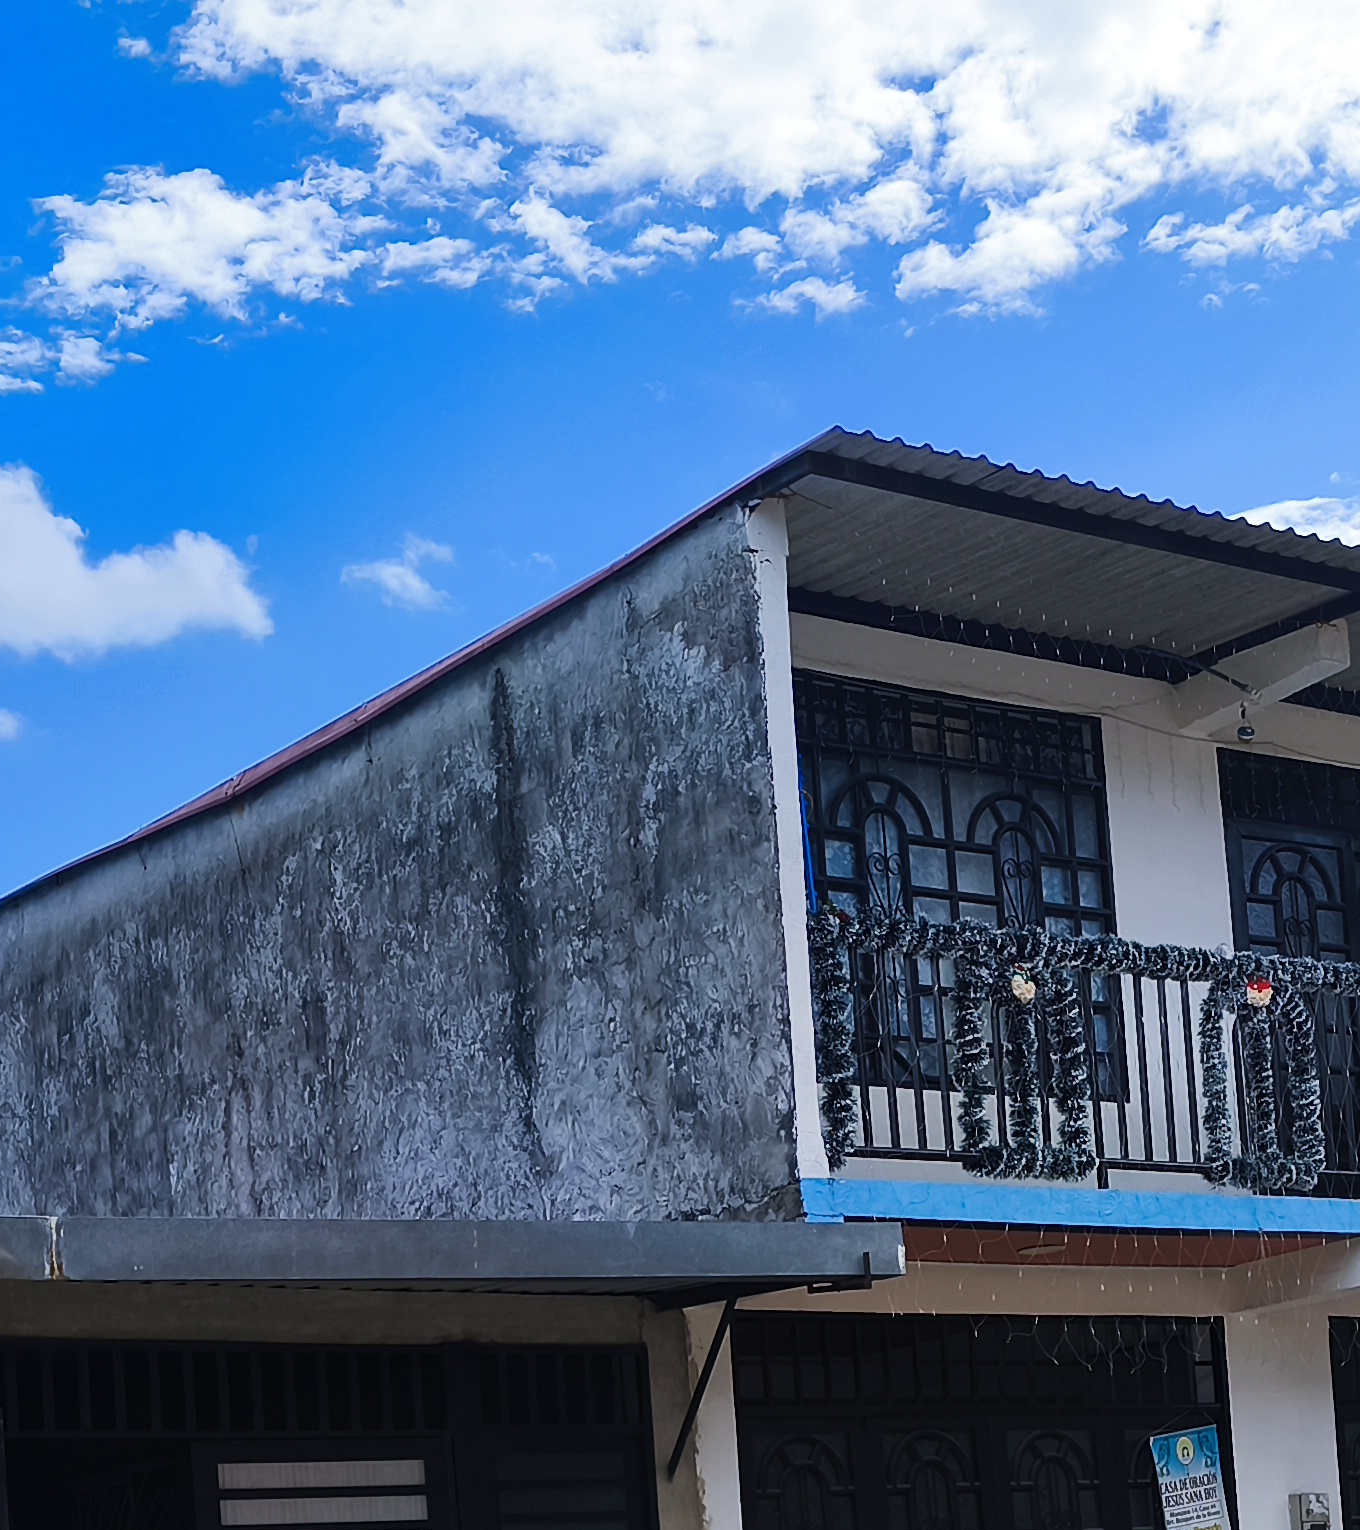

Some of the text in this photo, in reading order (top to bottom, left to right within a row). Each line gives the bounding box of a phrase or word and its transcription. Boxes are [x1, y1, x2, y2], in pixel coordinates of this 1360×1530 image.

[1159, 1480, 1178, 1495] CASA
[1179, 1477, 1189, 1492] DE
[1185, 1489, 1204, 1505] SANA
[1204, 1486, 1218, 1501] HOY
